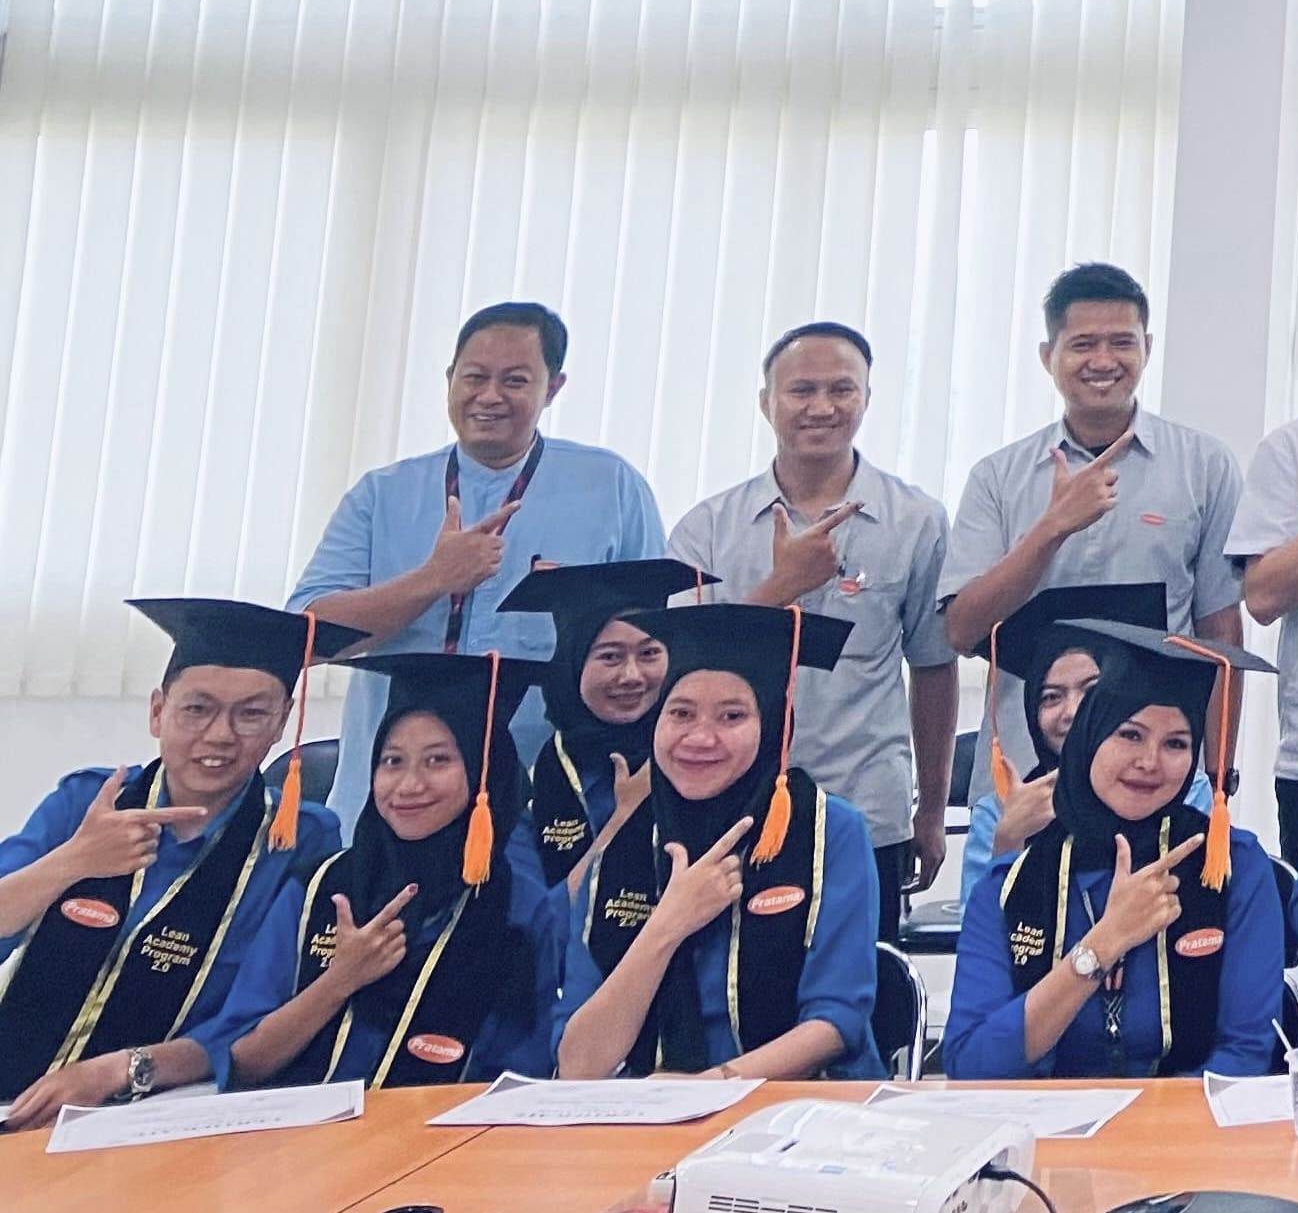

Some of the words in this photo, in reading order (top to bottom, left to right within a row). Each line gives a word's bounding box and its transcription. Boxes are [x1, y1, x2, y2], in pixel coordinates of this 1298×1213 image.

[541, 822, 588, 837] Academy
[553, 817, 579, 828] Lean
[619, 888, 648, 902] Lean
[751, 891, 802, 910] Pratama
[63, 899, 117, 925] Pratama
[160, 925, 191, 942] Lean
[1016, 921, 1044, 937] Lean
[142, 933, 199, 956] Academy
[140, 944, 191, 966] Program
[150, 960, 171, 973] 2.0
[408, 1036, 464, 1059] Pratama
